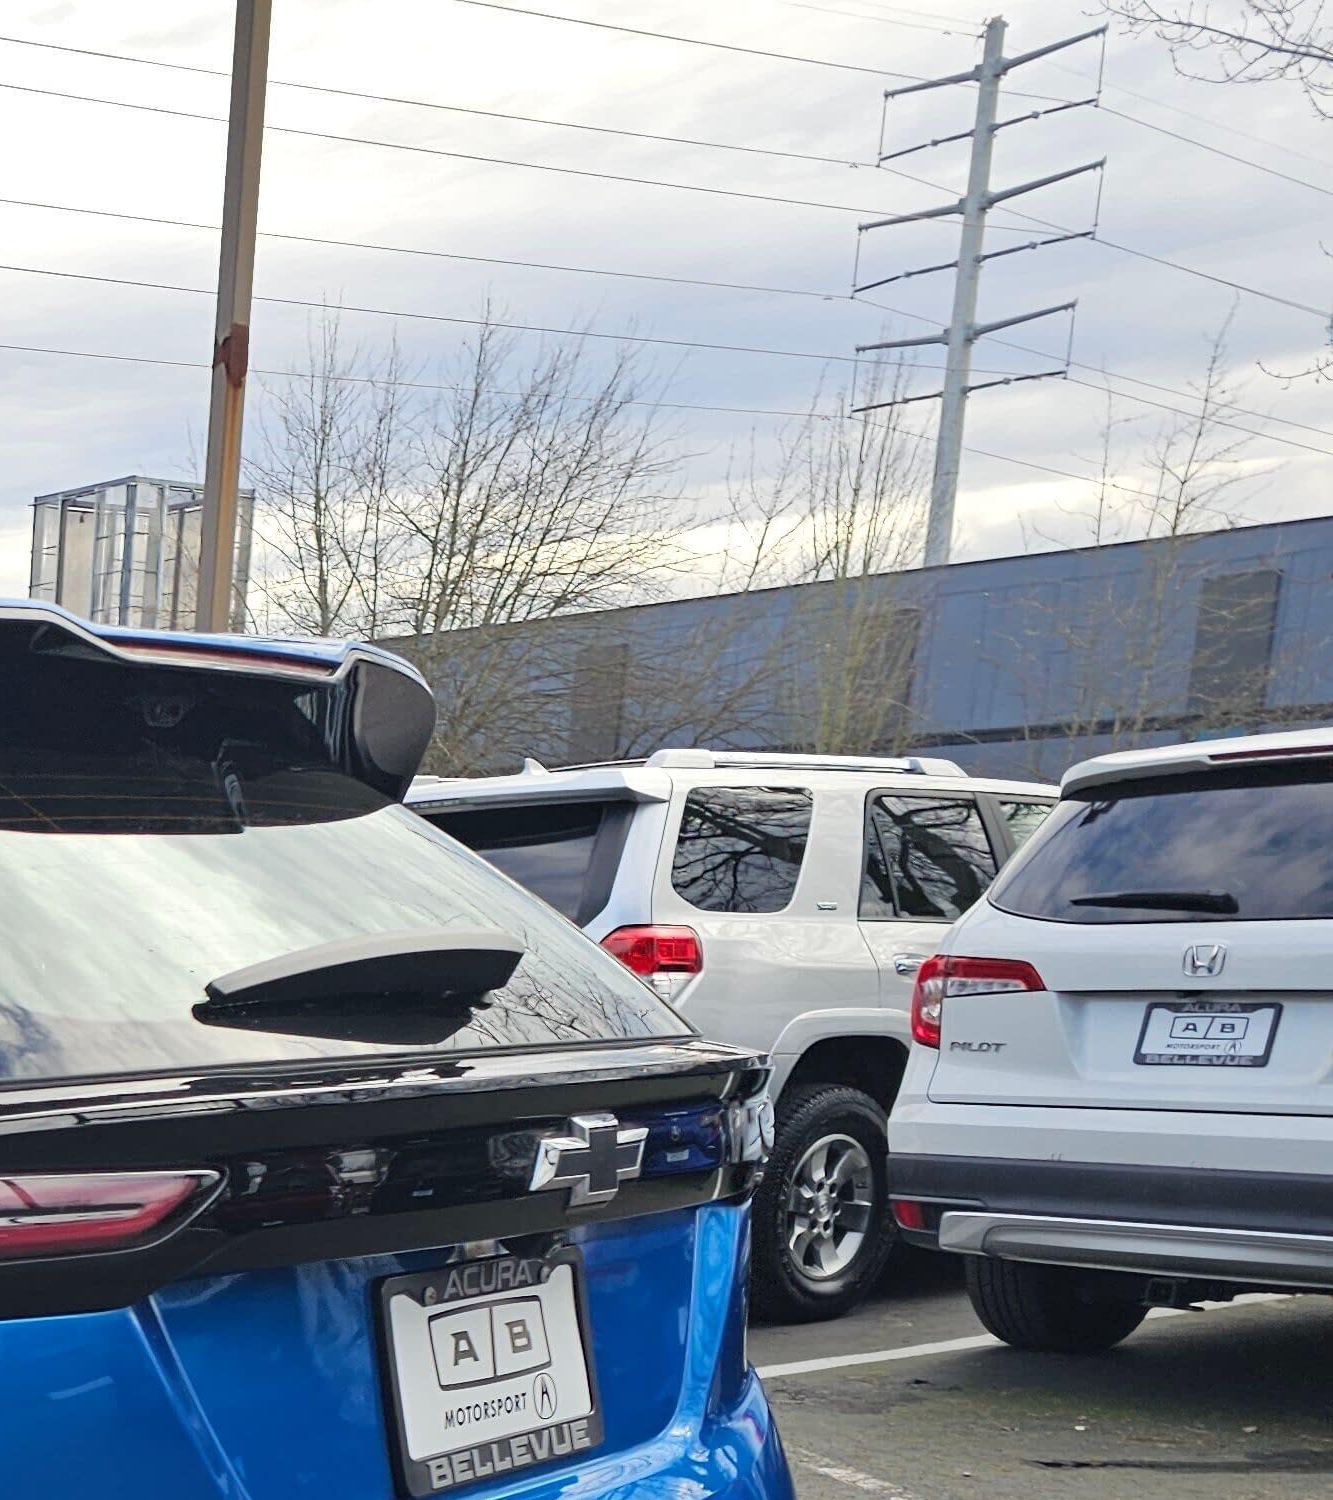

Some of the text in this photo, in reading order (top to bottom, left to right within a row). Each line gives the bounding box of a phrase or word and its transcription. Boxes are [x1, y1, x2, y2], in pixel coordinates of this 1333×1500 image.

[950, 1041, 1008, 1053] PILOT
[1146, 1054, 1254, 1065] BELLEVUE
[444, 1258, 534, 1298] ACURA
[444, 1392, 527, 1429] MOTORSPORT
[426, 1419, 591, 1490] BELLEVUE
